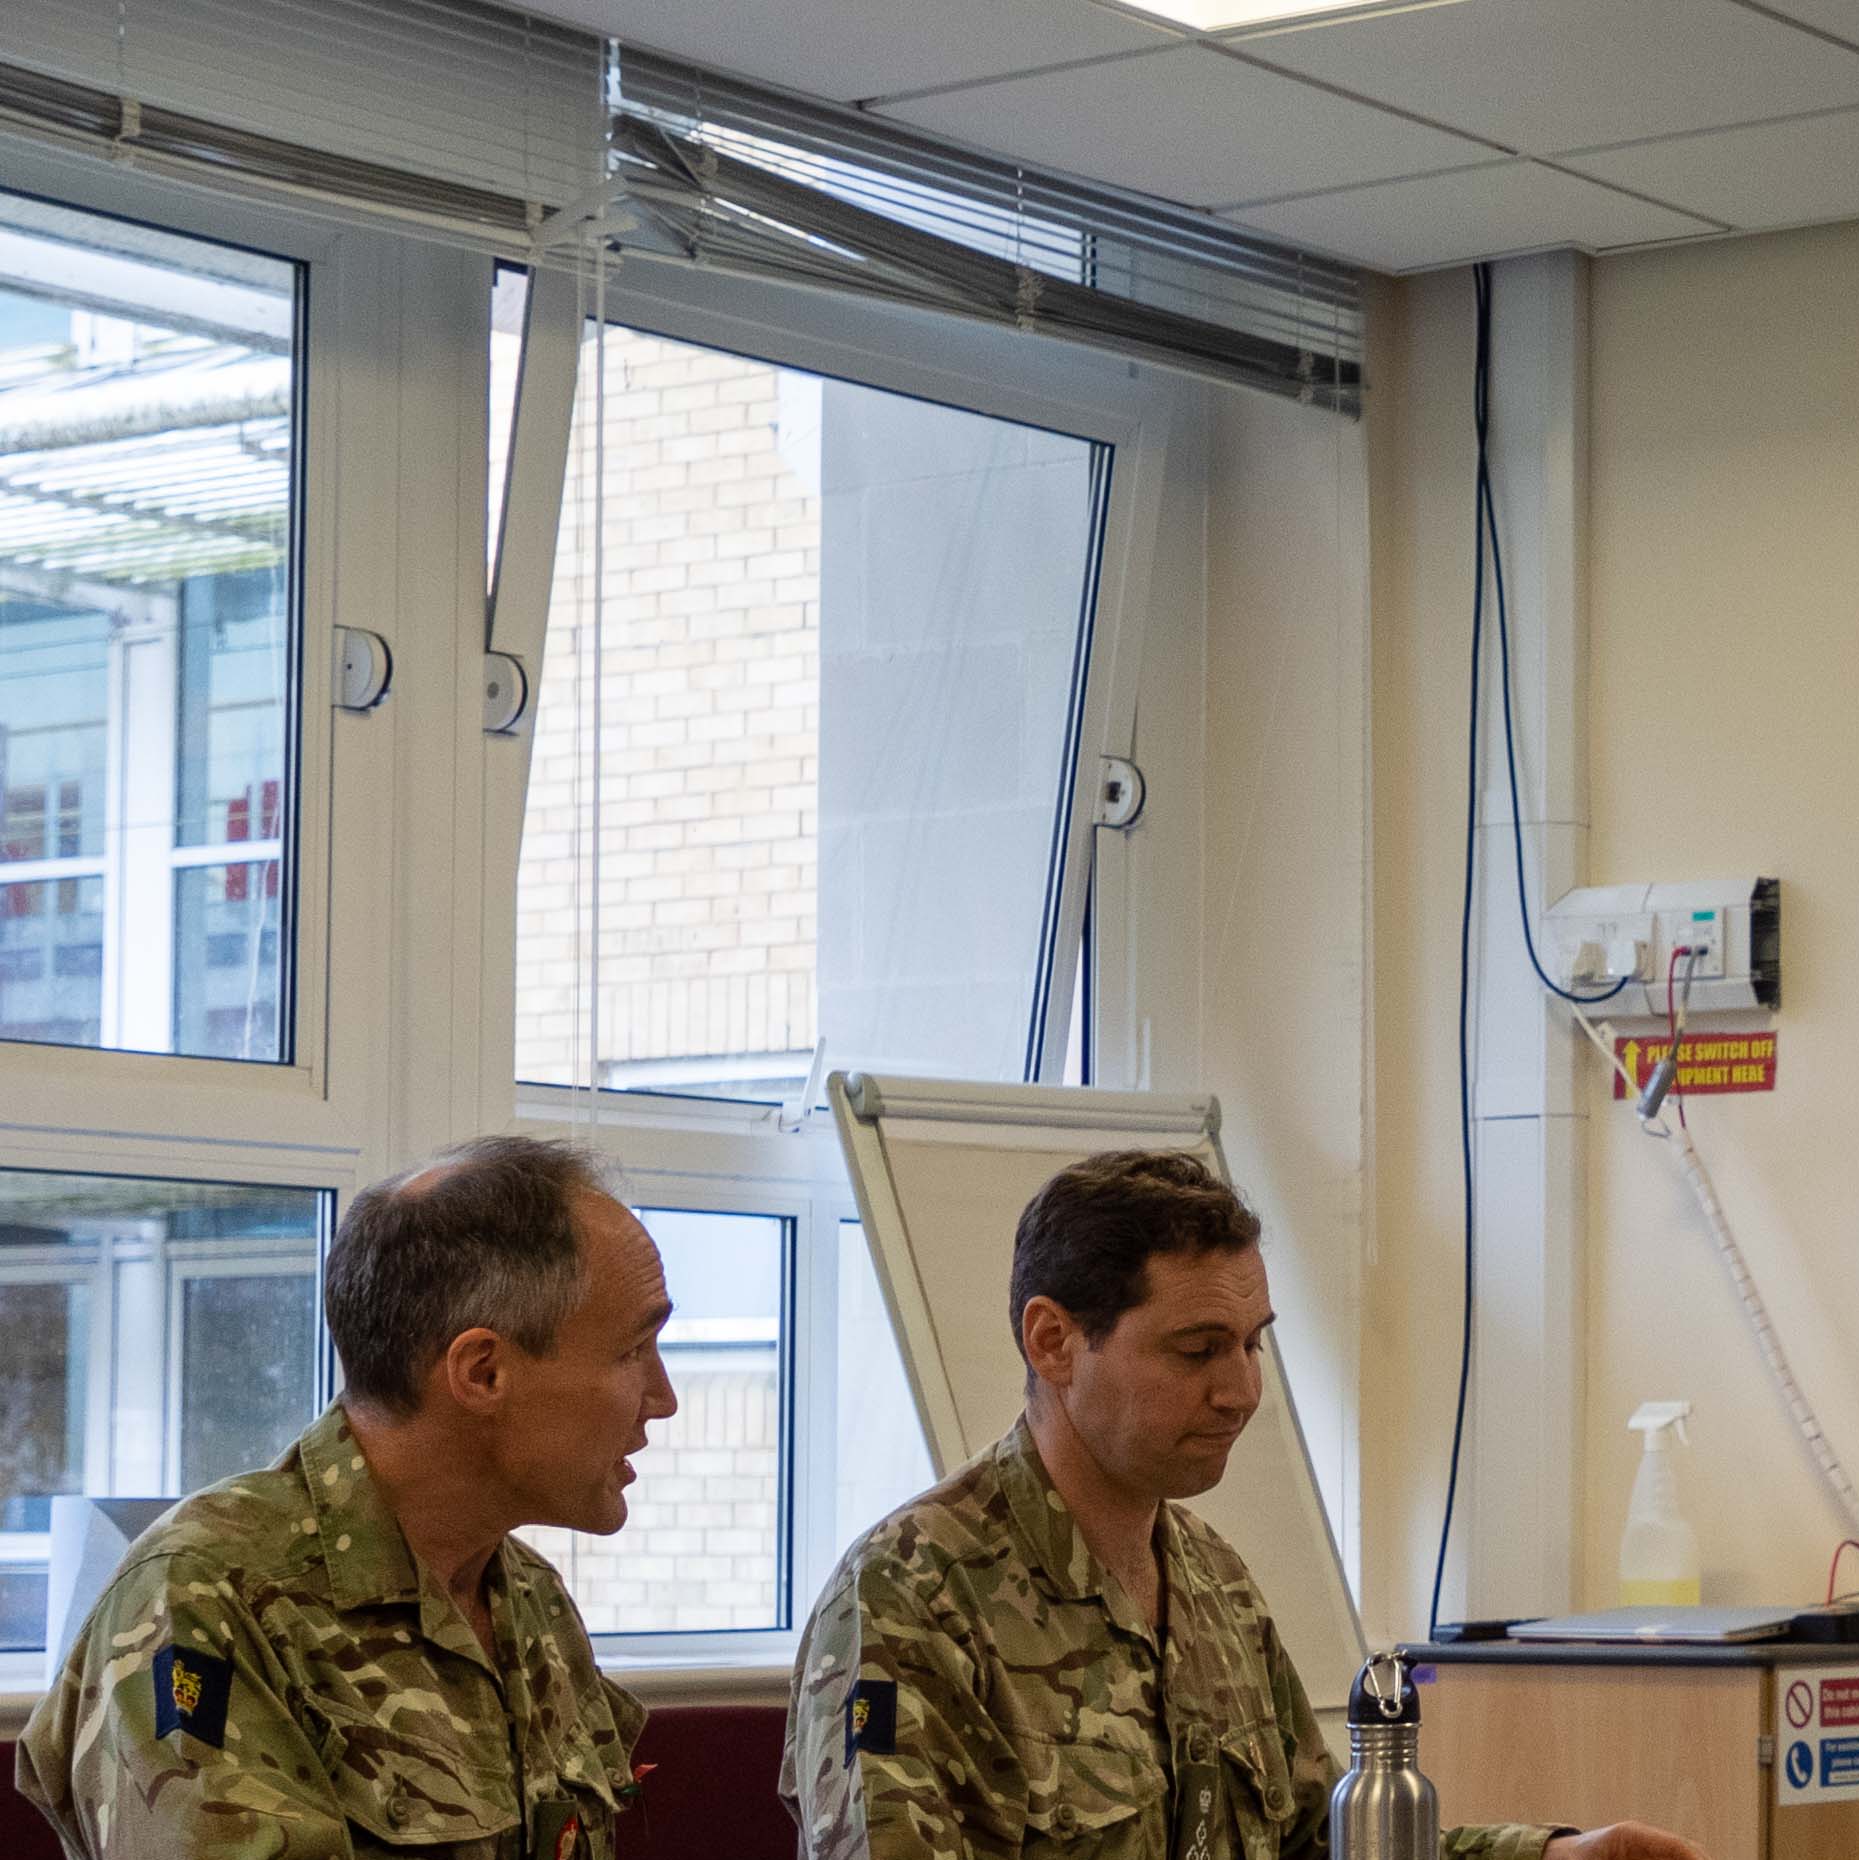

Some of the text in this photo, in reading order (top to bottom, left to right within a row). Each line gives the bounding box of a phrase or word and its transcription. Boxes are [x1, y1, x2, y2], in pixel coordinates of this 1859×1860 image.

[1647, 1039, 1774, 1064] PLESE SWITCH OFF
[1732, 1064, 1765, 1083] HERE
